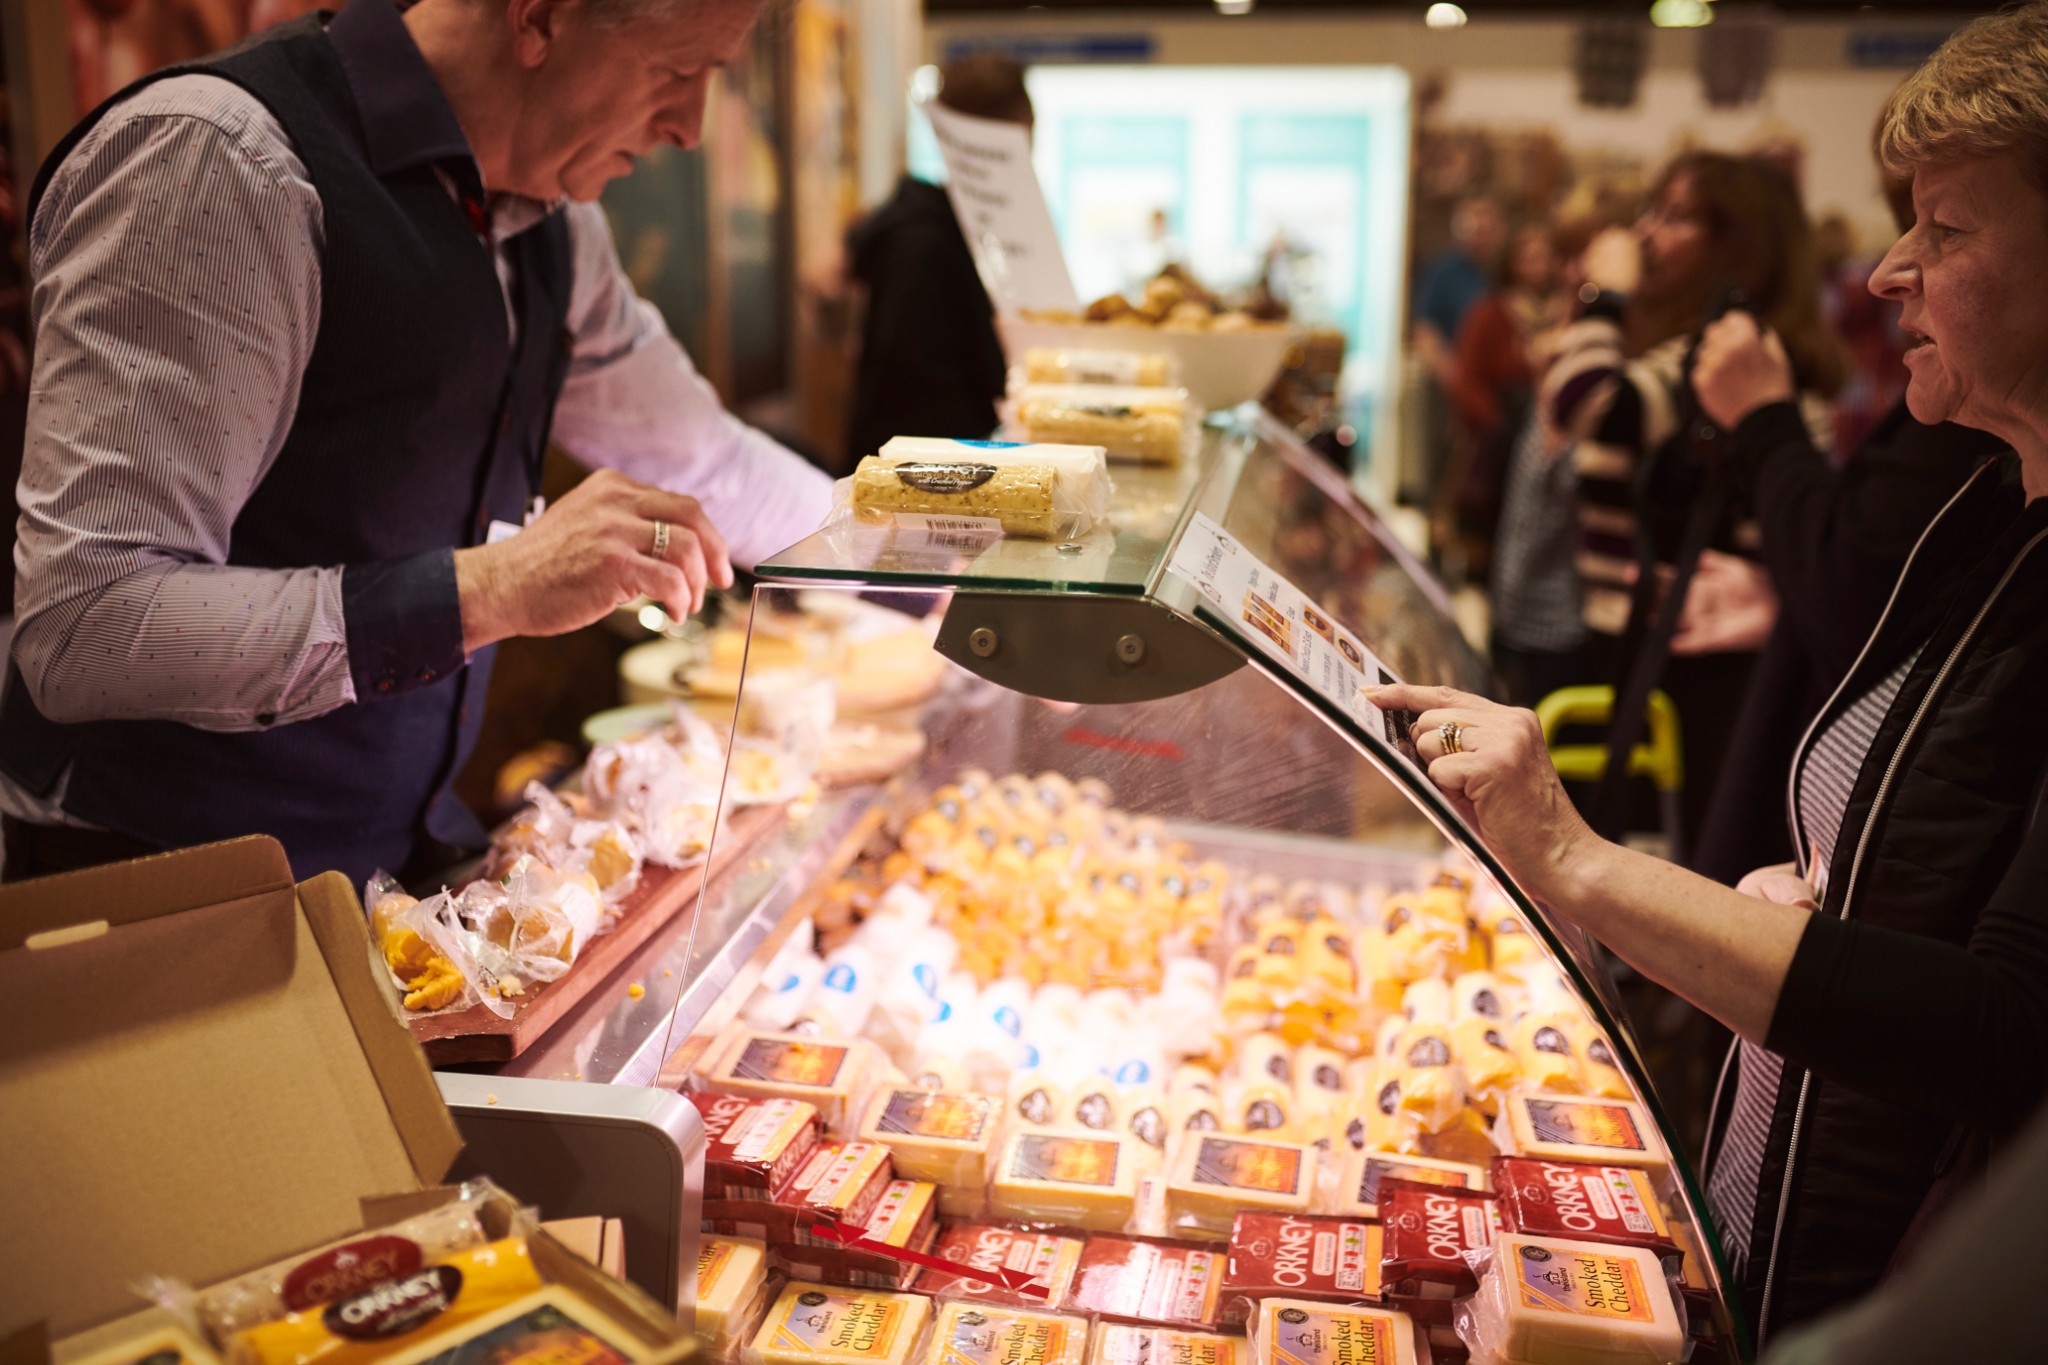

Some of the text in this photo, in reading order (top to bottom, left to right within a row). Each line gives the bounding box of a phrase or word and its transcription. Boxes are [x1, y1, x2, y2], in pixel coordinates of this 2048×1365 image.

[1540, 1162, 1597, 1231] ORKNEY
[1272, 1214, 1313, 1287] ORKNEY
[1424, 1193, 1462, 1260] ORKNEY
[960, 1226, 1014, 1294] OKNEY
[1574, 1258, 1606, 1309] Smoked
[1605, 1259, 1632, 1313] Cheddar
[341, 1270, 440, 1324] ORKNEY
[830, 1302, 866, 1348] Smoked
[854, 1302, 889, 1352] Cheddar
[1355, 1320, 1376, 1365] heddar
